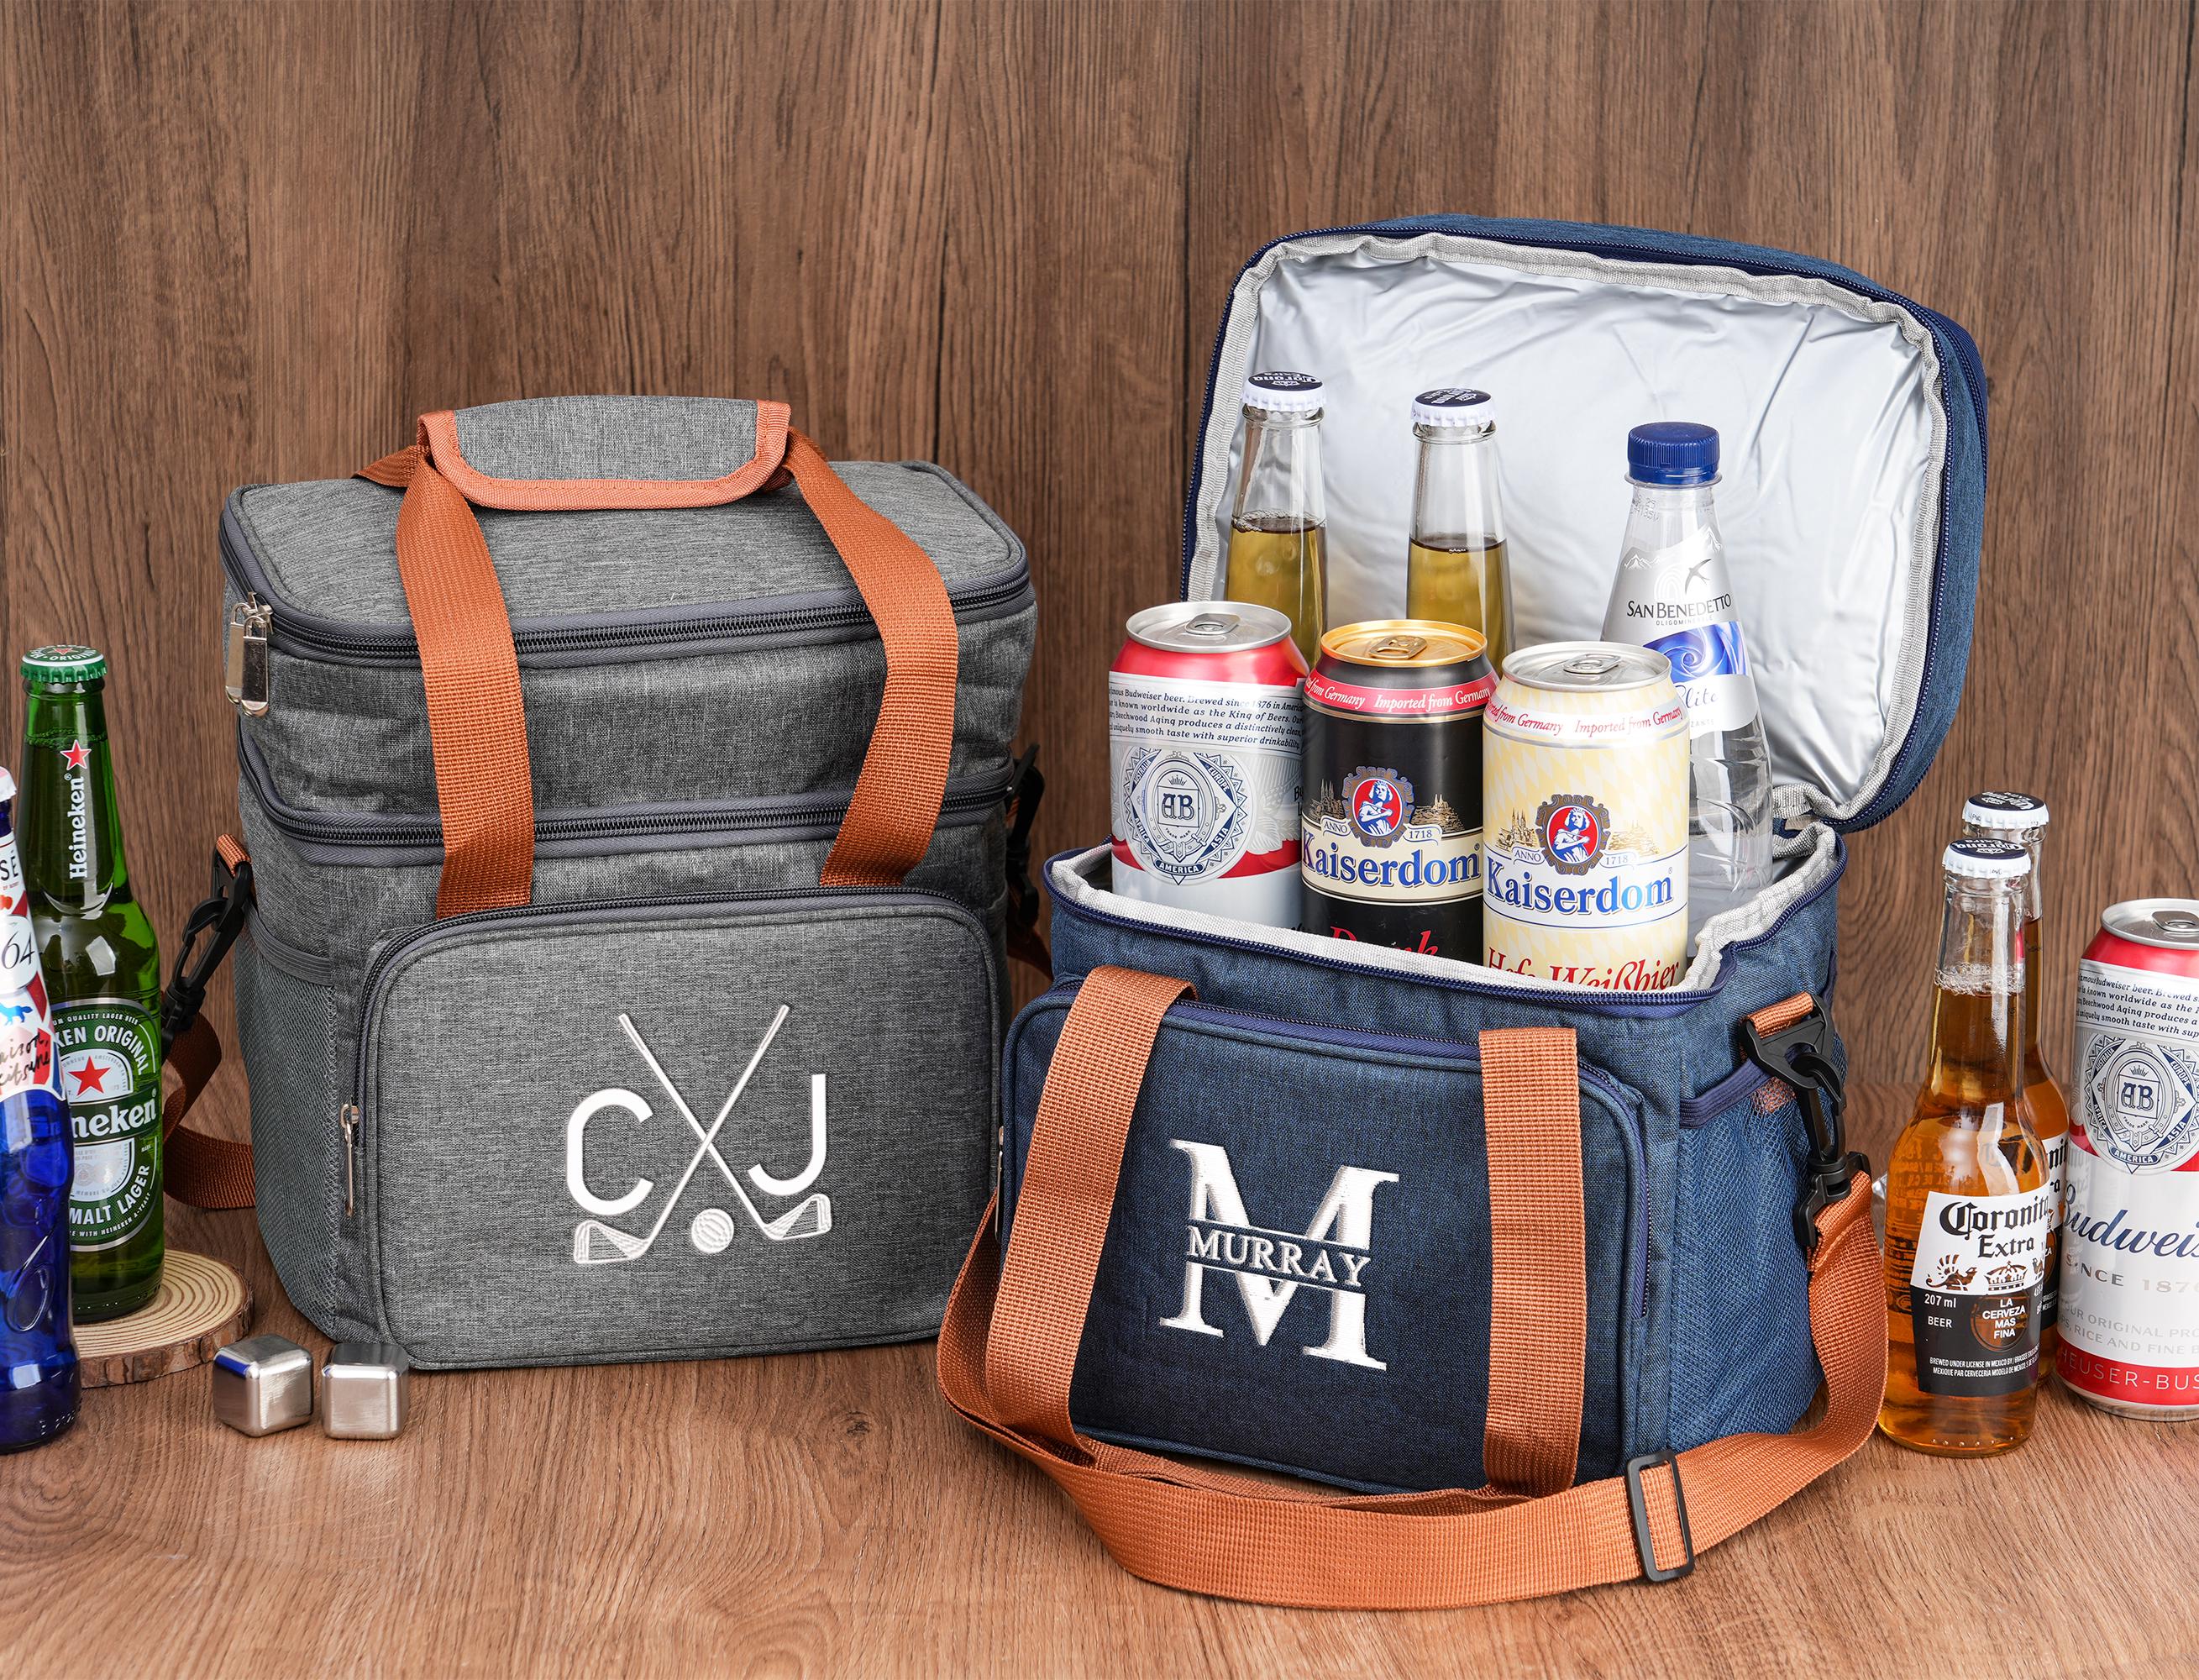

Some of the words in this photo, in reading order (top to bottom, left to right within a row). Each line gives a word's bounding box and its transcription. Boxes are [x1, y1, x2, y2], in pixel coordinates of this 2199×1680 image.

[1125, 689, 1162, 701] Budweiser
[1164, 693, 1185, 702] beer.
[1188, 696, 1224, 706] Brewed
[1273, 701, 1281, 710] in
[1325, 686, 1366, 709] Germany
[1374, 694, 1425, 712] Imported
[1426, 695, 1452, 711] from
[1455, 687, 1490, 705] Germany
[1119, 700, 1138, 709] known
[1141, 704, 1190, 714] worldwide
[1229, 710, 1252, 720] King
[1256, 712, 1266, 721] of
[1267, 713, 1290, 722] Beers.
[1518, 713, 1564, 736] Germany
[1574, 720, 1625, 737] Imported
[1628, 717, 1651, 734] from
[1653, 706, 1683, 725] Germany
[1115, 711, 1147, 722] Beechwood
[1178, 719, 1223, 729] produces
[1235, 722, 1285, 736] distinctively
[1136, 727, 1164, 735] smooth
[1167, 729, 1190, 738] taste
[1193, 732, 1214, 740] with
[1217, 734, 1257, 743] superior
[1208, 765, 1230, 791] EUROPE
[1162, 793, 1194, 820] AB
[67, 776, 88, 879] Heineken
[1134, 817, 1150, 844] AFRICA
[1210, 827, 1230, 849] ASIA
[1324, 821, 1347, 833] ANNO
[1409, 829, 1432, 839] 1718
[1159, 862, 1199, 874] AMERICA
[1302, 827, 1481, 887] Kaiserdom
[1514, 850, 1541, 863] ANNO
[1606, 856, 1628, 865] 1718
[1487, 856, 1672, 915] Kaiserdom
[2097, 977, 2130, 991] Budweiser
[2132, 984, 2154, 995] beer.
[2083, 998, 2115, 1011] Beechwood
[2144, 1011, 2189, 1024] produces
[2086, 986, 2106, 998] known
[2109, 992, 2157, 1007] worldwide
[2176, 1001, 2192, 1013] the
[67, 1013, 99, 1022] QUALITY
[2102, 1015, 2129, 1026] smooth
[2133, 1019, 2155, 1031] taste
[2158, 1023, 2179, 1034] with
[94, 1025, 149, 1075] ORIGINAL
[2170, 1061, 2191, 1086] EUROPE
[2121, 1082, 2154, 1110] AB
[2093, 1104, 2107, 1130] AFRICA
[2167, 1121, 2186, 1142] ASIA
[566, 1088, 653, 1215] C
[748, 1074, 827, 1196] J
[2114, 1150, 2154, 1163] AMERICA
[69, 1205, 112, 1225] MALT
[117, 1165, 150, 1215] LAGER
[101, 1218, 133, 1236] HEINEKEN
[1159, 1138, 1399, 1371] M
[1187, 1226, 1371, 1287] MURRAY
[1978, 1235, 2034, 1258] Extra
[1924, 1294, 1942, 1306] 207
[1944, 1298, 1956, 1308] ml
[2000, 1299, 2013, 1308] LA
[1928, 1315, 1952, 1328] BEER
[1982, 1306, 2025, 1320] CERVEZA
[1995, 1319, 2016, 1329] MAS
[1994, 1329, 2015, 1339] FINA
[2088, 1314, 2163, 1337] ORIGINAL
[2074, 1325, 2103, 1343] RICE
[2107, 1337, 2141, 1352] AND
[2147, 1344, 2185, 1355] FINE
[1929, 1357, 1949, 1367] BREWED
[1950, 1358, 1965, 1368] UNDER
[1933, 1367, 1954, 1377] MEXIQUE
